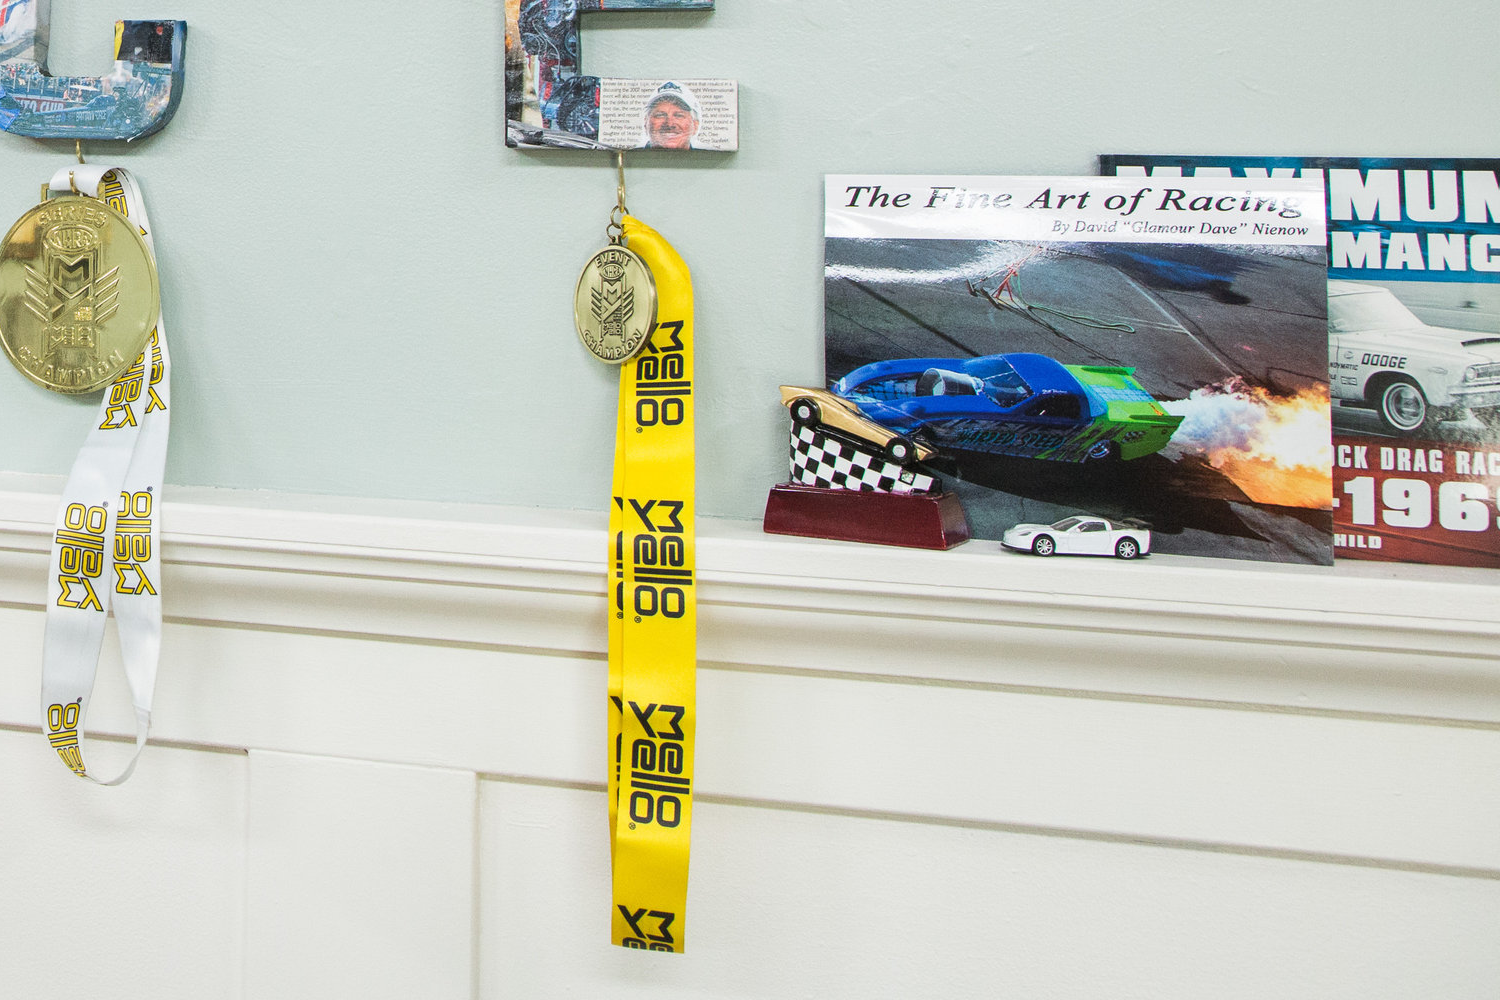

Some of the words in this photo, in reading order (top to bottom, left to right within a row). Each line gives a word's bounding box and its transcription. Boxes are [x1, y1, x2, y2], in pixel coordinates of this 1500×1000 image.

[845, 185, 912, 208] The
[923, 185, 1013, 209] Fine
[1022, 186, 1091, 210] Art
[1103, 187, 1152, 216] of
[1156, 188, 1303, 219] Racing
[1052, 219, 1071, 234] By
[1073, 219, 1119, 234] David
[1251, 222, 1309, 236] Nienow
[595, 251, 631, 268] EVENT
[583, 328, 643, 359] CHAMPION
[1361, 352, 1408, 370] DODGE
[1332, 444, 1369, 470] CK
[1380, 446, 1444, 473] DRAG
[1332, 475, 1500, 532] -196
